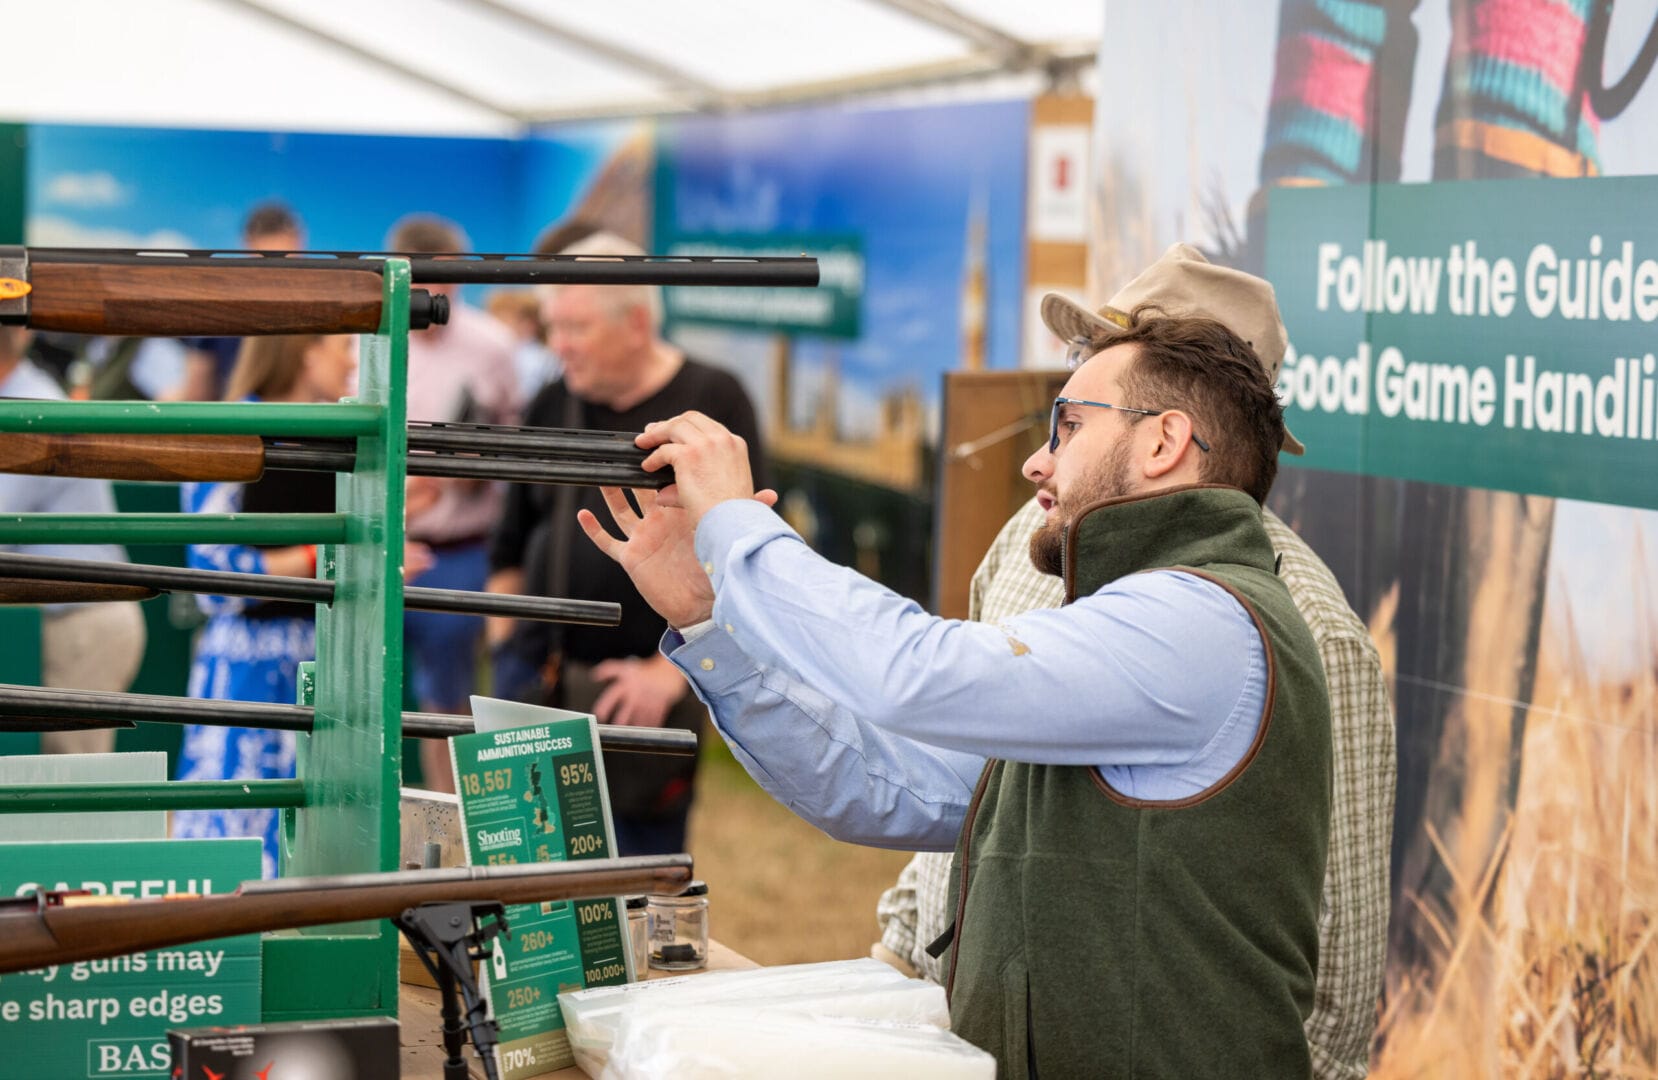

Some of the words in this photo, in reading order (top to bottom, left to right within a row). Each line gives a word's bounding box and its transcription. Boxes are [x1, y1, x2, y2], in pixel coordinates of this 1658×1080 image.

[1316, 239, 1442, 313] Follow
[1448, 240, 1518, 317] the
[1525, 234, 1658, 322] Guide
[1376, 346, 1496, 425] Game
[1503, 353, 1658, 440] Handli
[494, 727, 550, 745] SUSTAINABLE
[477, 742, 535, 762] AMMUNITION
[534, 737, 572, 753] SUCCESS
[462, 768, 512, 796] 18,567
[560, 763, 593, 786] 95%
[477, 827, 522, 847] Shooting
[570, 834, 603, 856] 200+
[578, 902, 613, 925] 100%
[521, 930, 554, 953] 260+
[71, 952, 147, 981] guns
[156, 949, 224, 977] may
[585, 964, 625, 984] 100,000+
[0, 1000, 20, 1021] e
[29, 993, 120, 1025] sharp
[129, 990, 223, 1023] edges
[507, 985, 541, 1009] 250+
[506, 1047, 536, 1070] 70%
